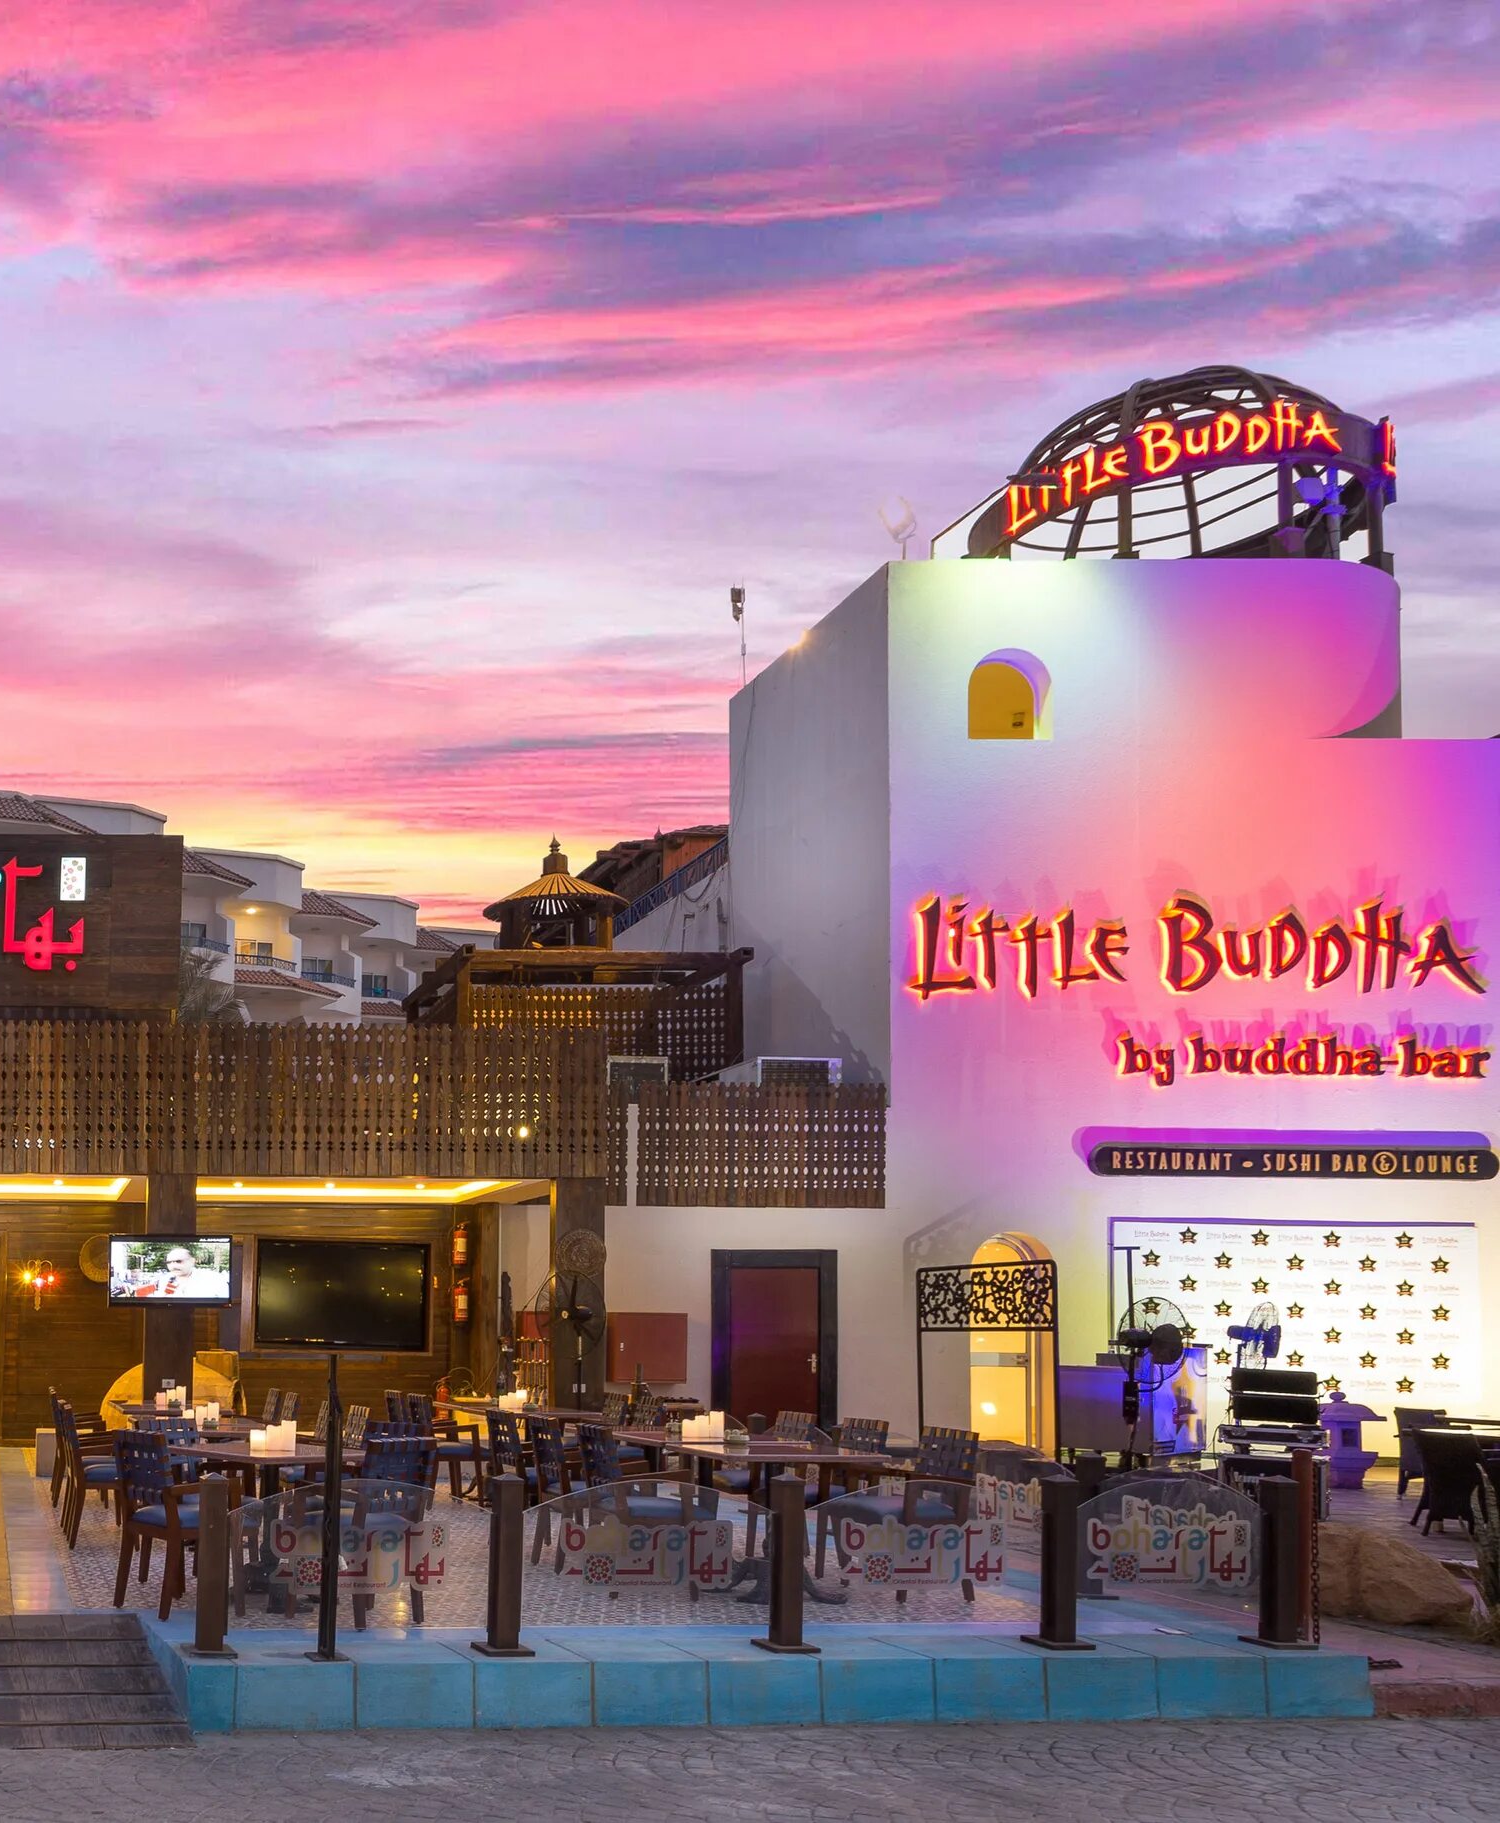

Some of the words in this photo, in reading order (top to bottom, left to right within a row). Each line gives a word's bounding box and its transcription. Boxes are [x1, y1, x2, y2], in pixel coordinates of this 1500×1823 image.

[1116, 1031, 1175, 1086] by
[1112, 1150, 1233, 1172] RESTAURANT
[1262, 1153, 1321, 1173] SUSHI
[1332, 1153, 1367, 1173] BAR
[1402, 1154, 1479, 1174] LOUNGE
[845, 1517, 983, 1554] boharat
[1092, 1518, 1228, 1555] boharat
